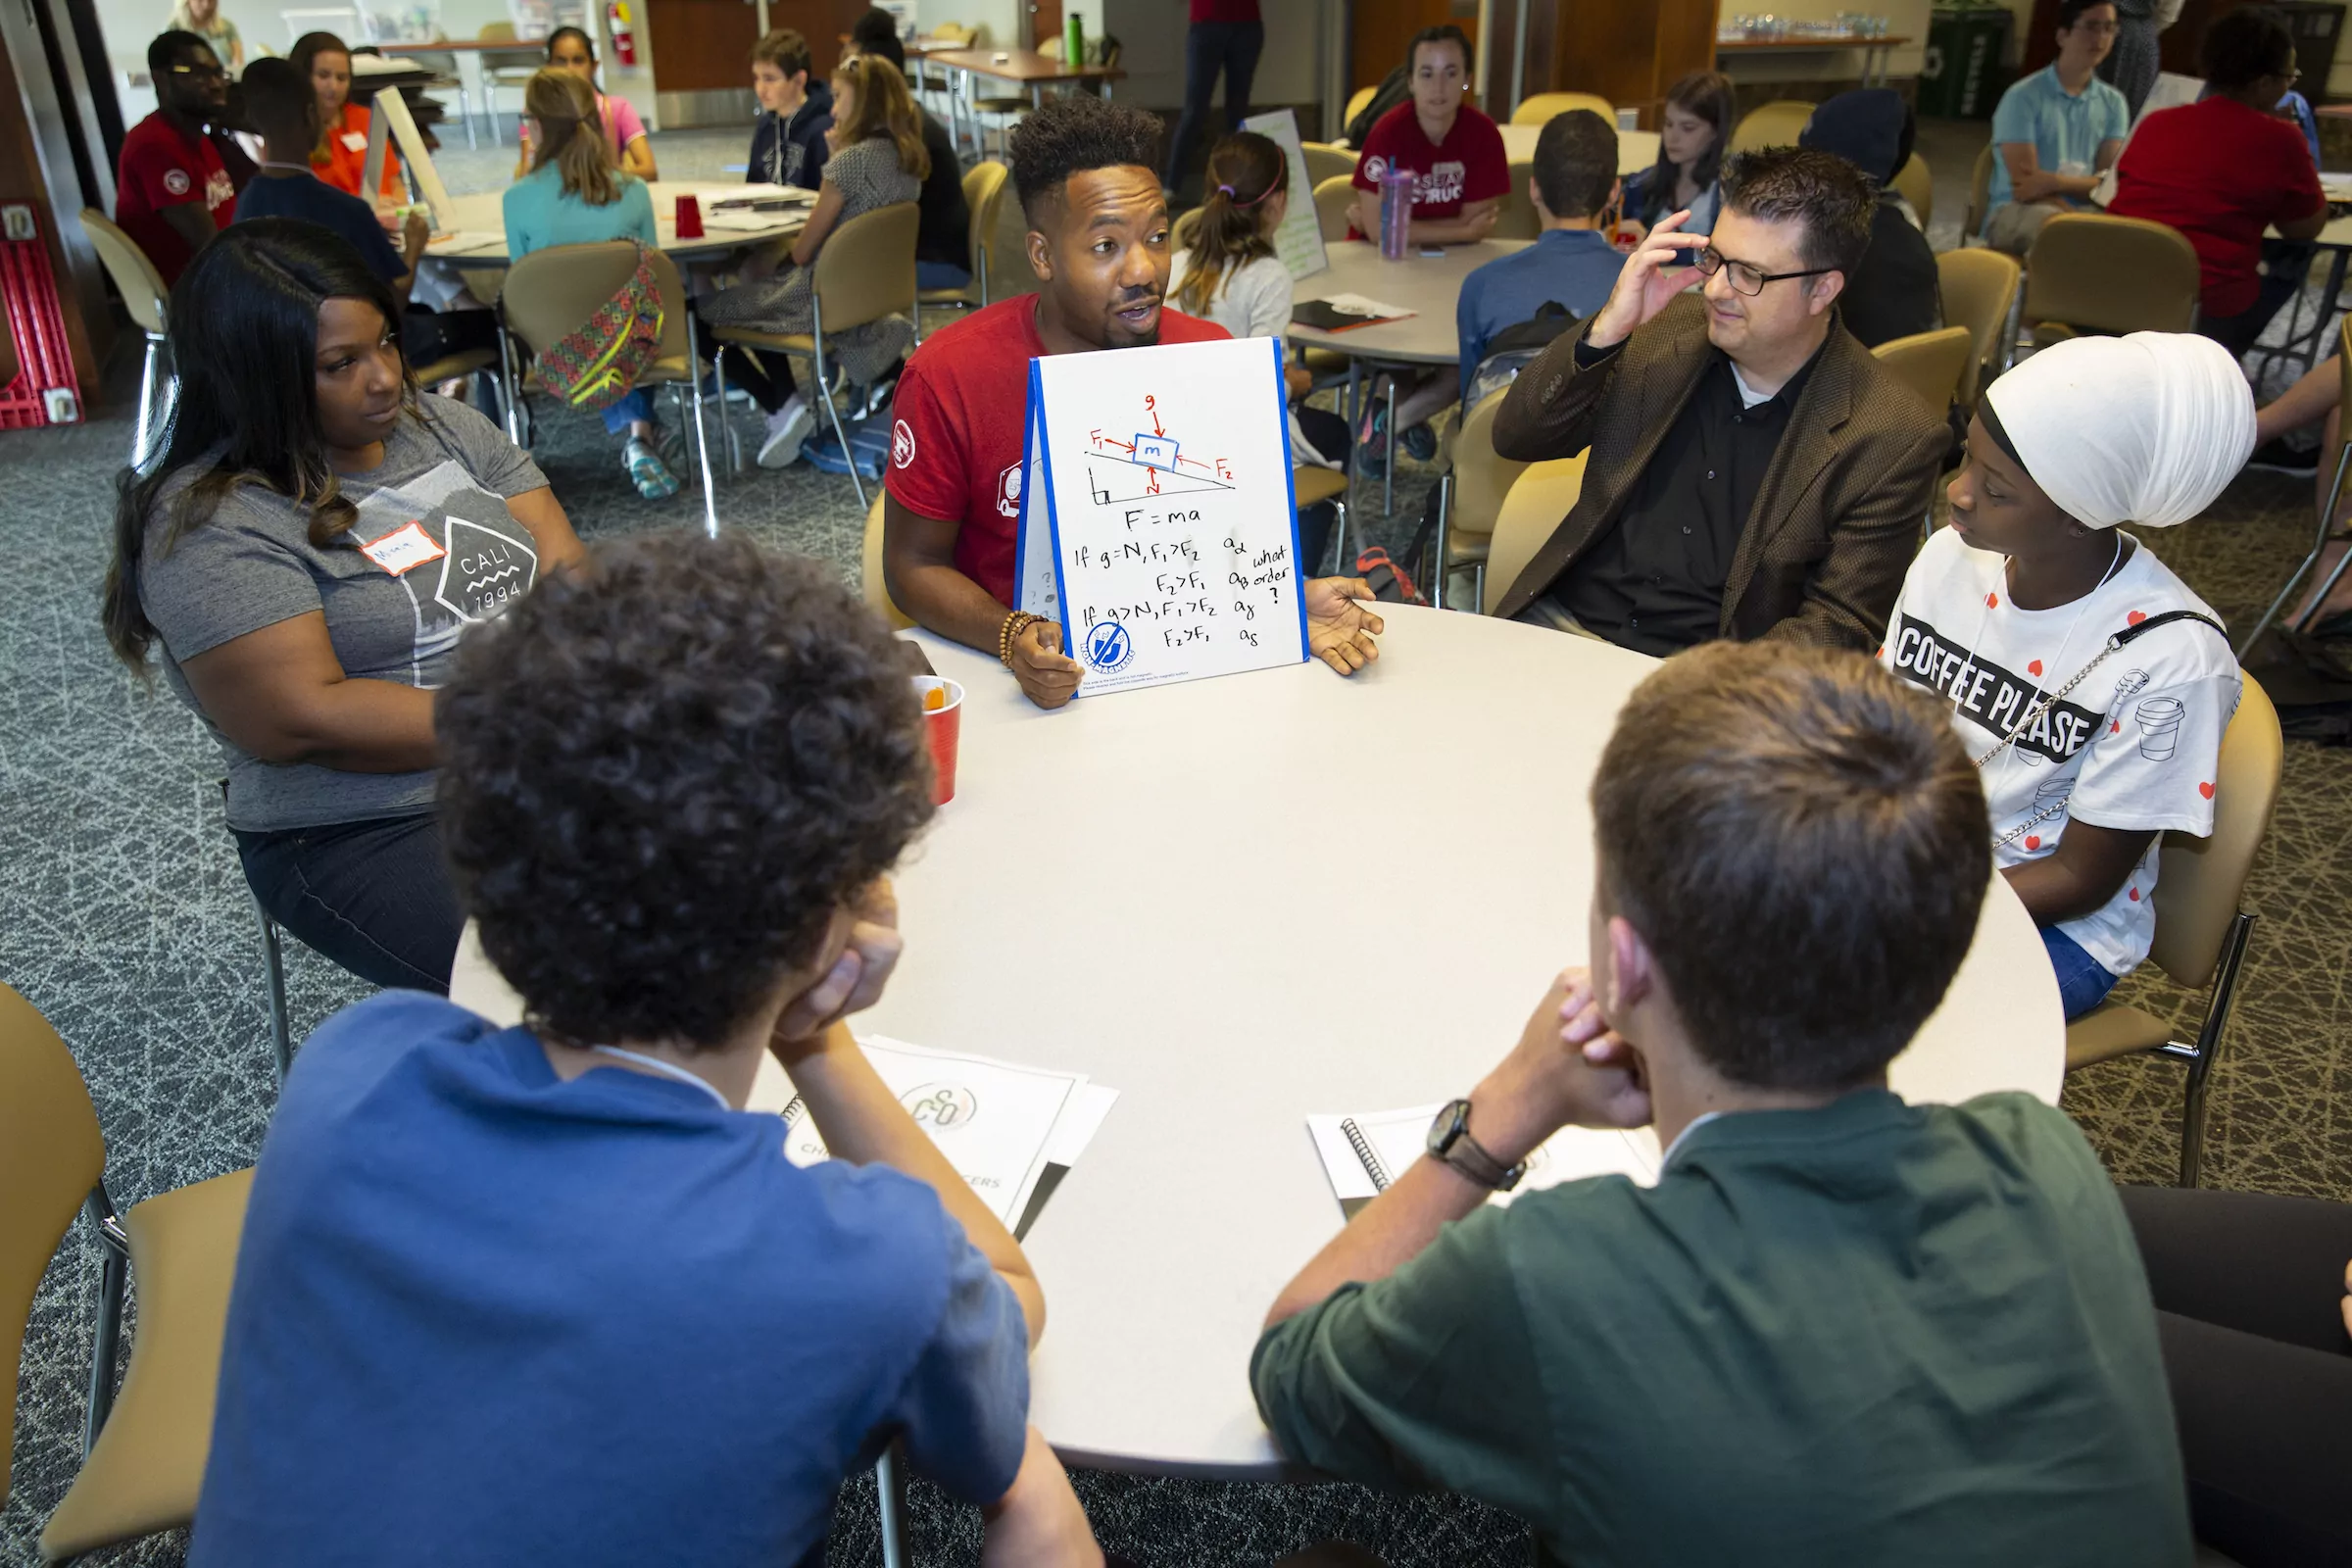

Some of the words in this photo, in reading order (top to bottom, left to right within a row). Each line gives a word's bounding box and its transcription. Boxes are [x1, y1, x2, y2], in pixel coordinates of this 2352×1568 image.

[1145, 394, 1155, 412] g
[1144, 446, 1161, 457] m
[460, 543, 512, 575] CALI
[1075, 545, 1091, 568] If
[1252, 544, 1289, 568] what
[1253, 566, 1290, 586] order
[474, 580, 521, 612] 1994
[1269, 586, 1279, 605] ?
[1083, 606, 1098, 627] If
[1079, 642, 1136, 675] NON-MAGNETIC
[1894, 626, 1996, 713] COFFEE
[1987, 680, 2091, 757] PLEASE
[801, 1143, 828, 1156] CH
